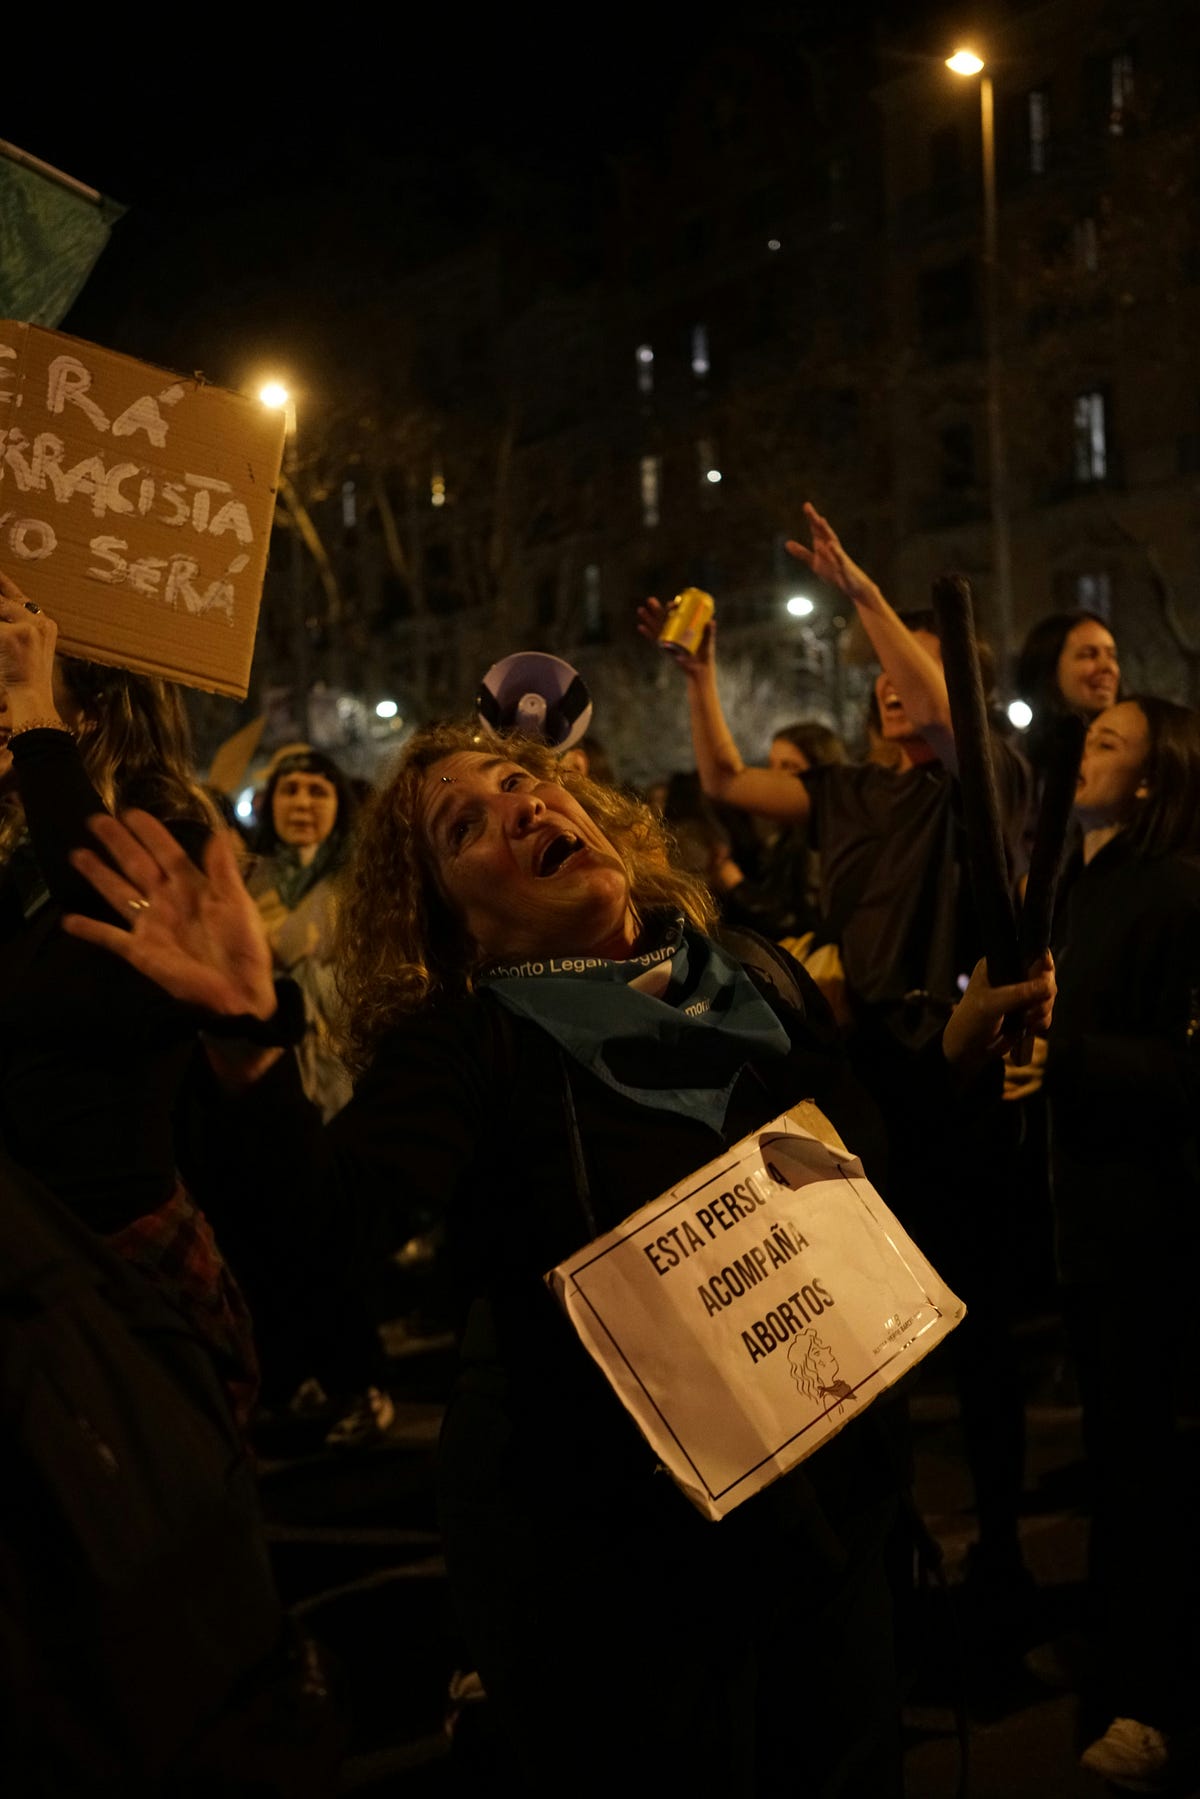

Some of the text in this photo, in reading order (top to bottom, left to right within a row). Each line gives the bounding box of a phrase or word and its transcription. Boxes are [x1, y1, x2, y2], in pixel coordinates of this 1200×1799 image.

[86, 535, 250, 628] SERÁ
[644, 1162, 791, 1276] ESTA PERSOA
[698, 1221, 809, 1318] ACOMPAÑA
[741, 1278, 835, 1364] ABORTOS
